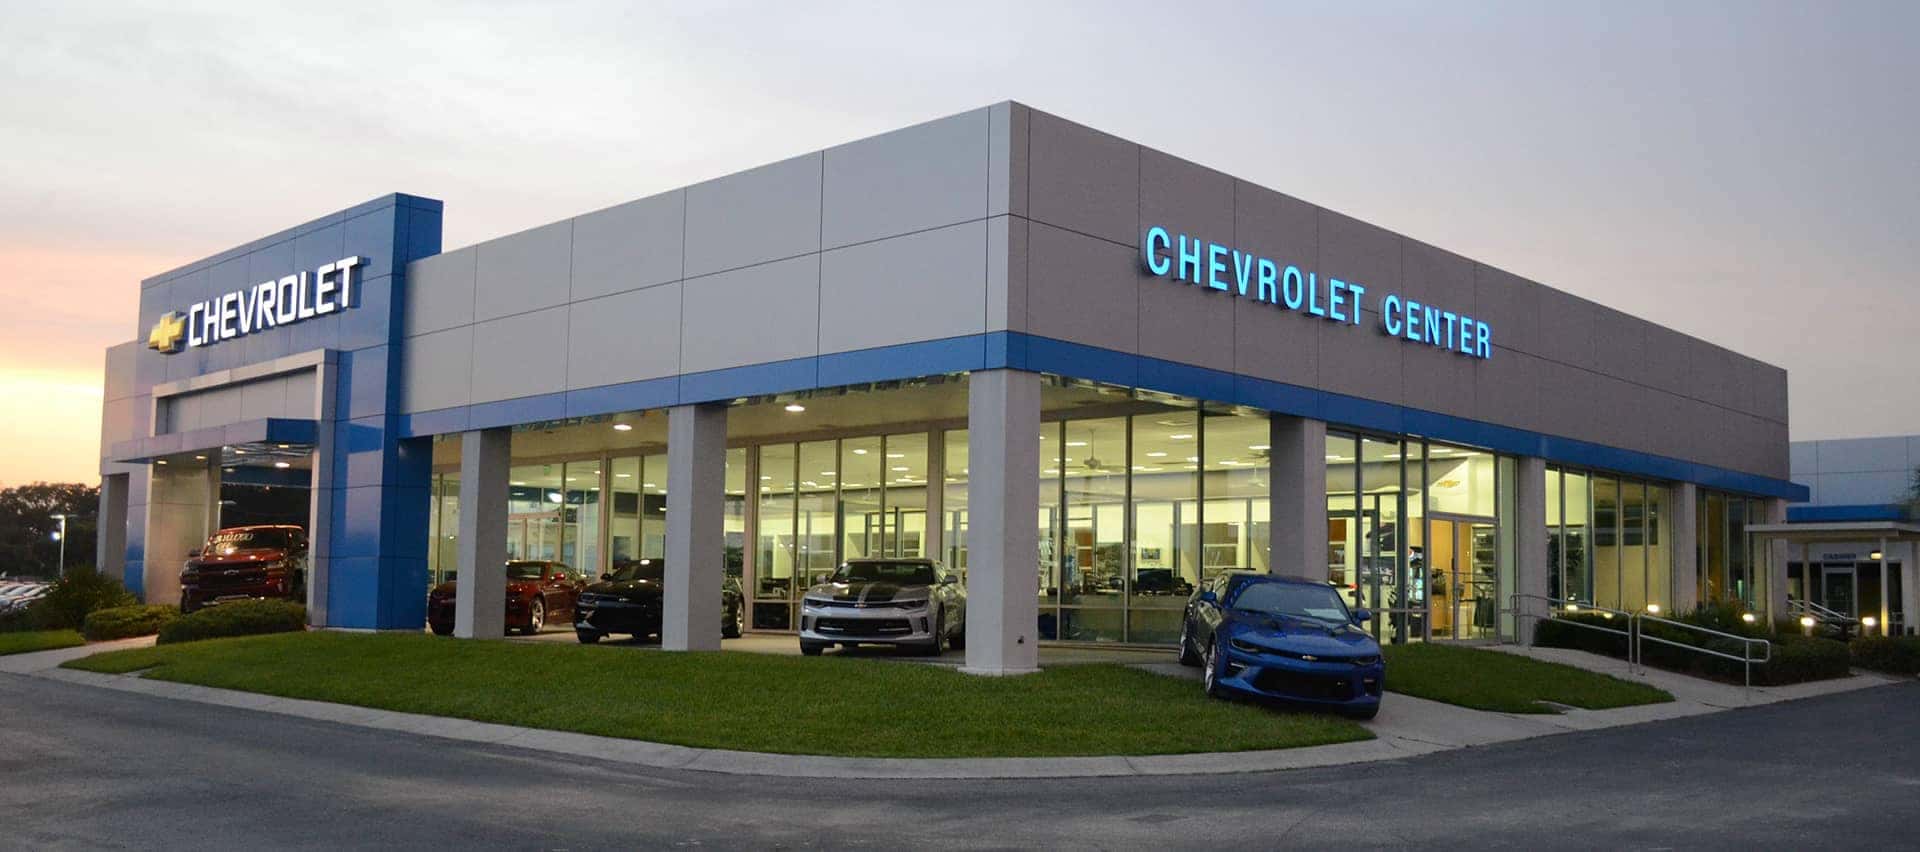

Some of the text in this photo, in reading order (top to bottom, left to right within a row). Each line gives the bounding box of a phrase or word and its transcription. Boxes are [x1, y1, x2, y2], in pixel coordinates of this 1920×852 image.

[188, 255, 361, 347] CHEVROLET
[1146, 226, 1491, 359] CHEVROLET CENTER
